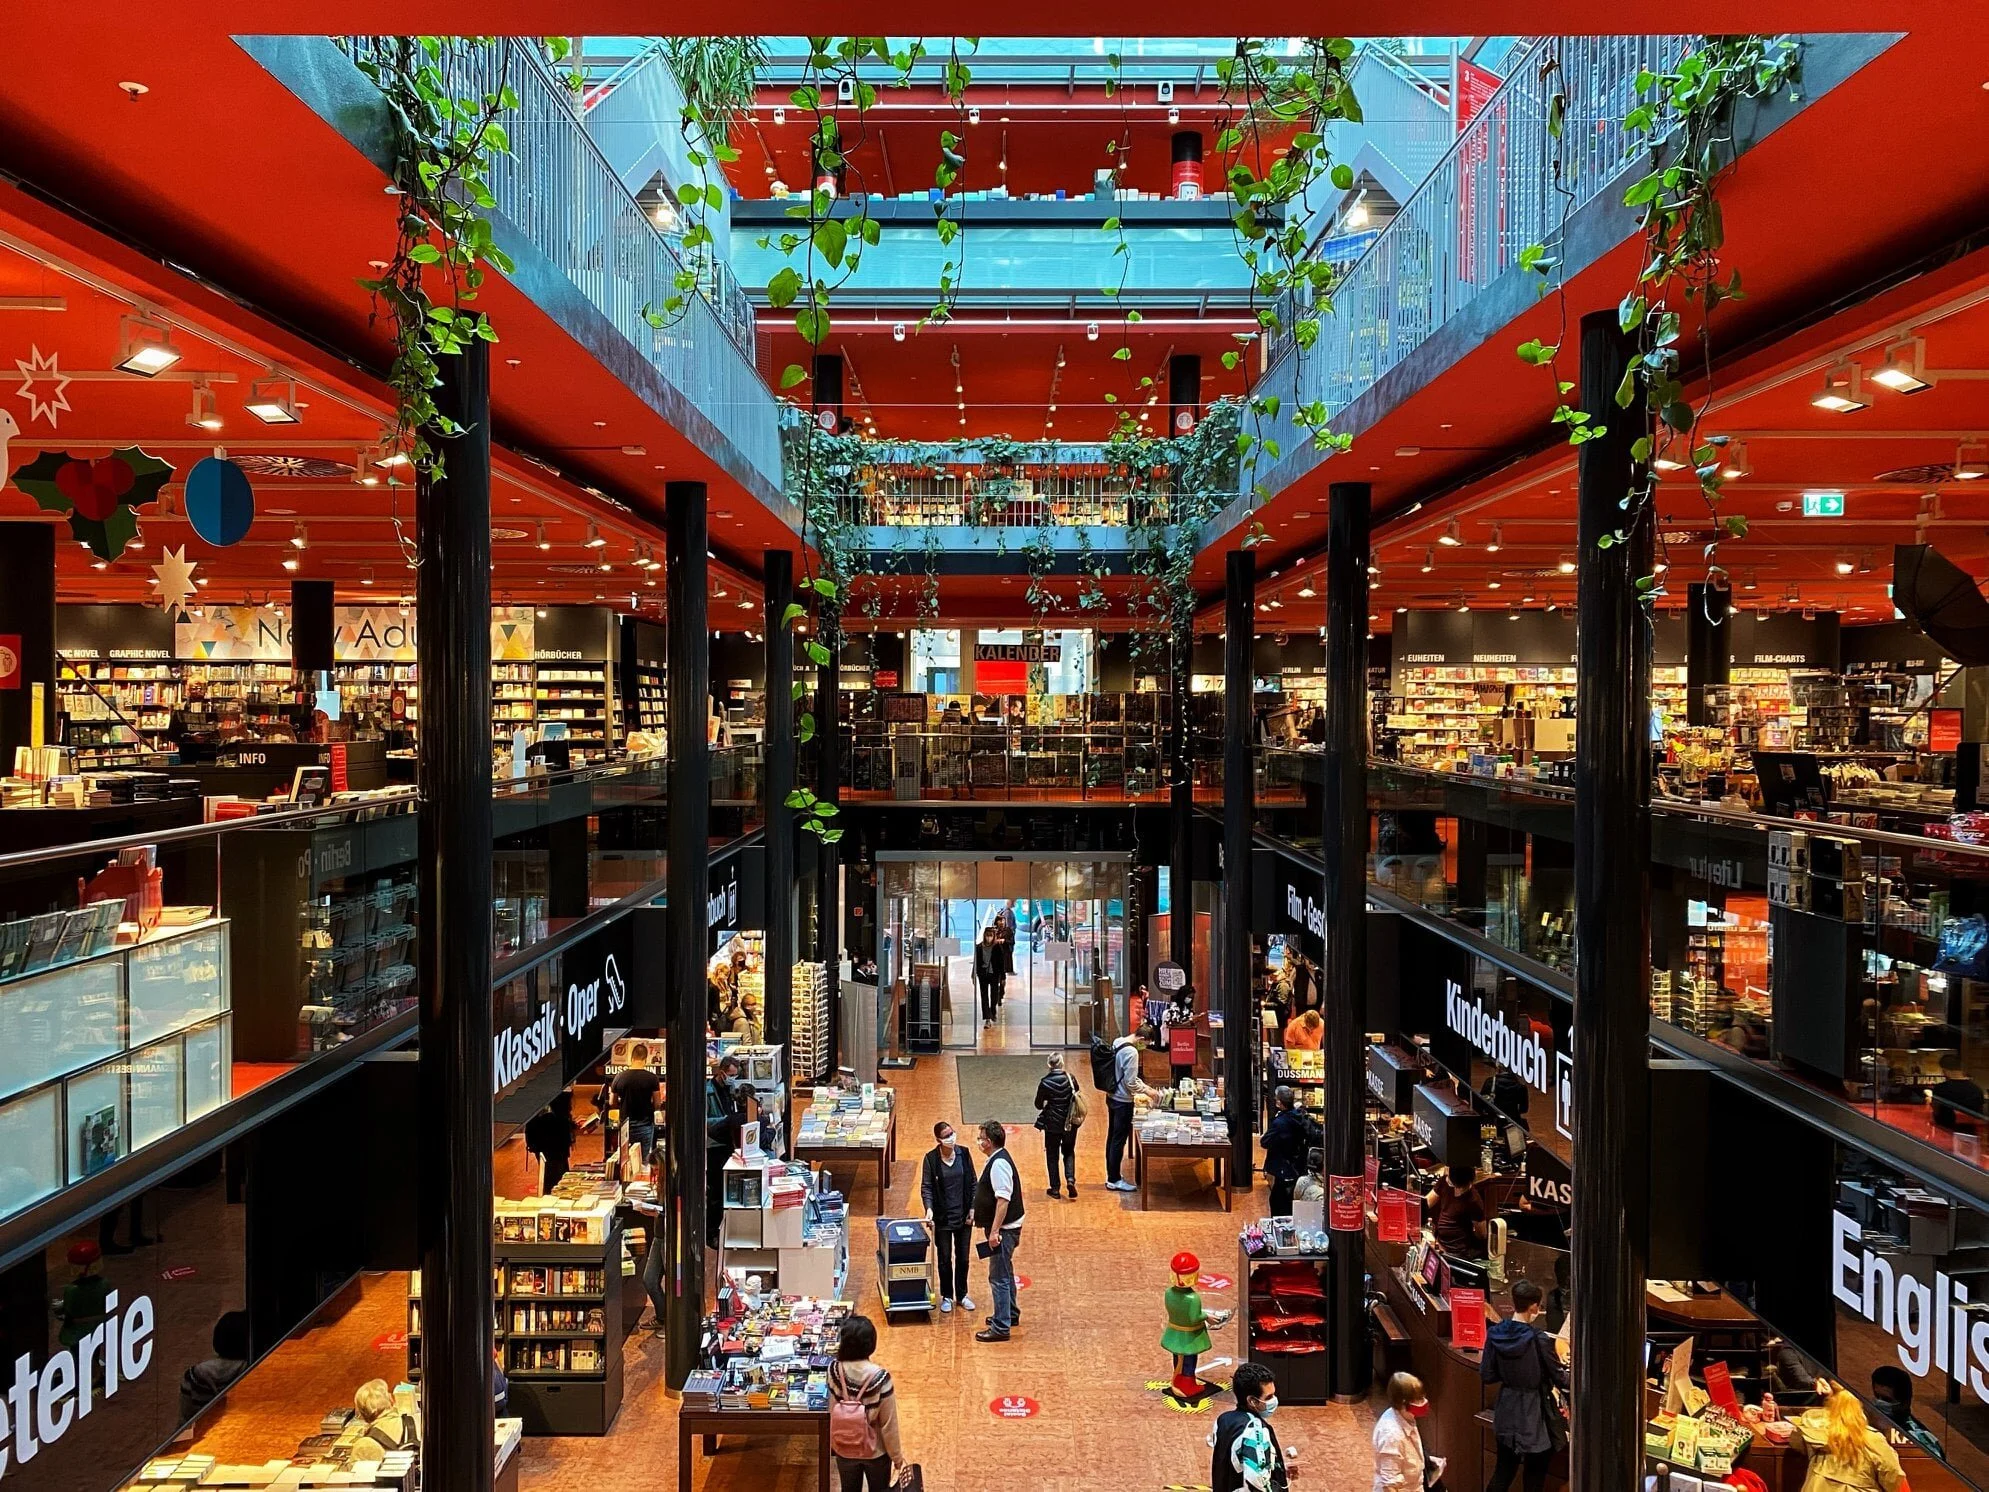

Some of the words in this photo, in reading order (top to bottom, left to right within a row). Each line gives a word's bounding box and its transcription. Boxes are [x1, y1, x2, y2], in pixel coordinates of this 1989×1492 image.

[74, 650, 100, 658] NOVEL
[110, 650, 144, 658] GRAPHIC
[145, 650, 170, 658] NOVEL
[534, 650, 582, 660] HÖRBÜCHER
[976, 646, 1060, 661] KALENDER
[1754, 654, 1806, 663] FILM-CHARTS
[239, 753, 266, 764] INFO
[318, 753, 330, 763] INFO
[1288, 884, 1302, 924] Film
[494, 1001, 556, 1095] Klassik
[568, 978, 600, 1042] Oper
[1446, 979, 1547, 1094] Kinderbuch
[1413, 1112, 1432, 1146] KASSE
